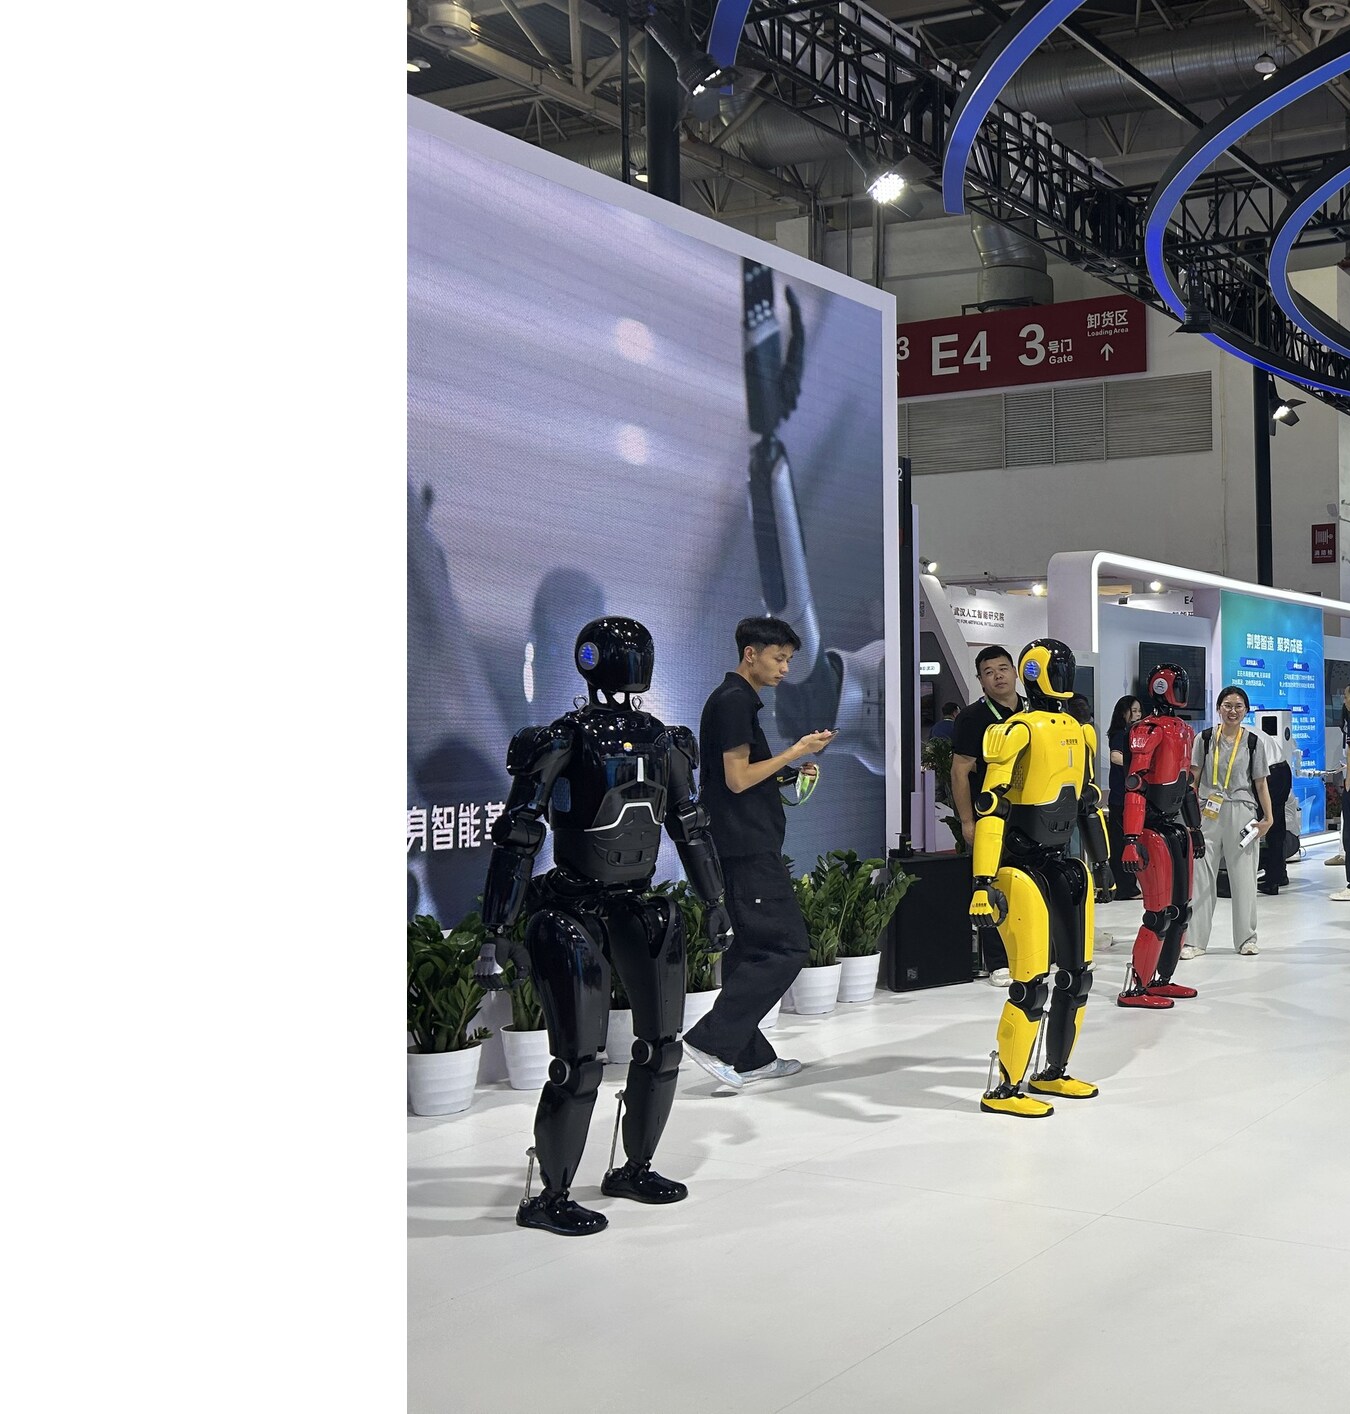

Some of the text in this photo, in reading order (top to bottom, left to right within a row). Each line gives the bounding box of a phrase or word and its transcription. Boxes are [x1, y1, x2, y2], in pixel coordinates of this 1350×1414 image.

[1086, 309, 1128, 330] 卸货区
[1087, 329, 1113, 337] Loading
[931, 330, 991, 376] E4
[1018, 323, 1073, 367] 3 号门
[1049, 354, 1074, 365] Gate
[954, 607, 1005, 621] 武汉人工智能研究院
[1246, 633, 1274, 651] 荆楚智造
